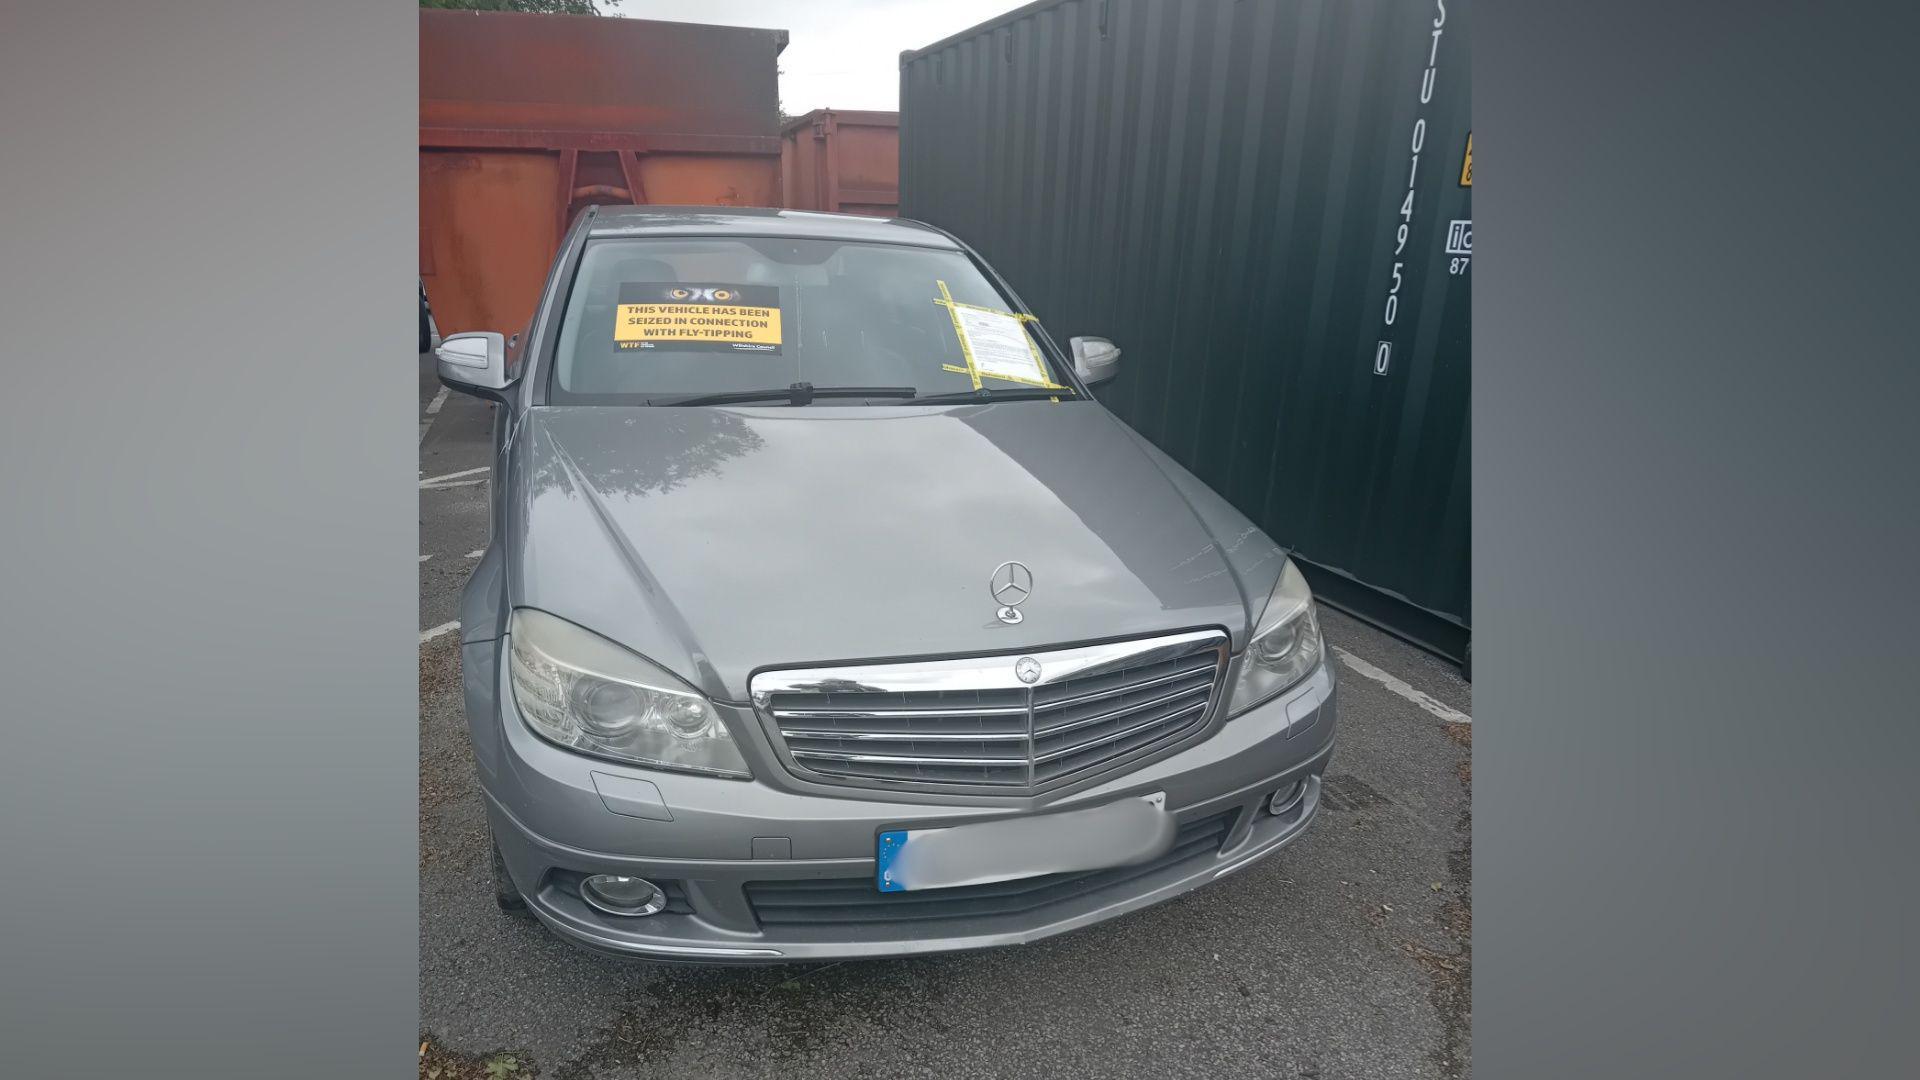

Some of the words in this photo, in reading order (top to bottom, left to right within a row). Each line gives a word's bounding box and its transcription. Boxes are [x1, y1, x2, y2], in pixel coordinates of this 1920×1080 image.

[1385, 118, 1425, 326] 014950
[1449, 257, 1470, 275] 87
[628, 306, 656, 314] THIS
[658, 306, 710, 315] VEHICLE
[712, 307, 736, 316] HAS
[739, 308, 770, 317] BEEN
[628, 317, 672, 325] SEIZED
[675, 317, 687, 325] IN
[689, 318, 768, 328] CONNECTION
[643, 328, 676, 336] WITH
[679, 329, 753, 339] FLY-TIPPING
[1375, 342, 1390, 374] 0
